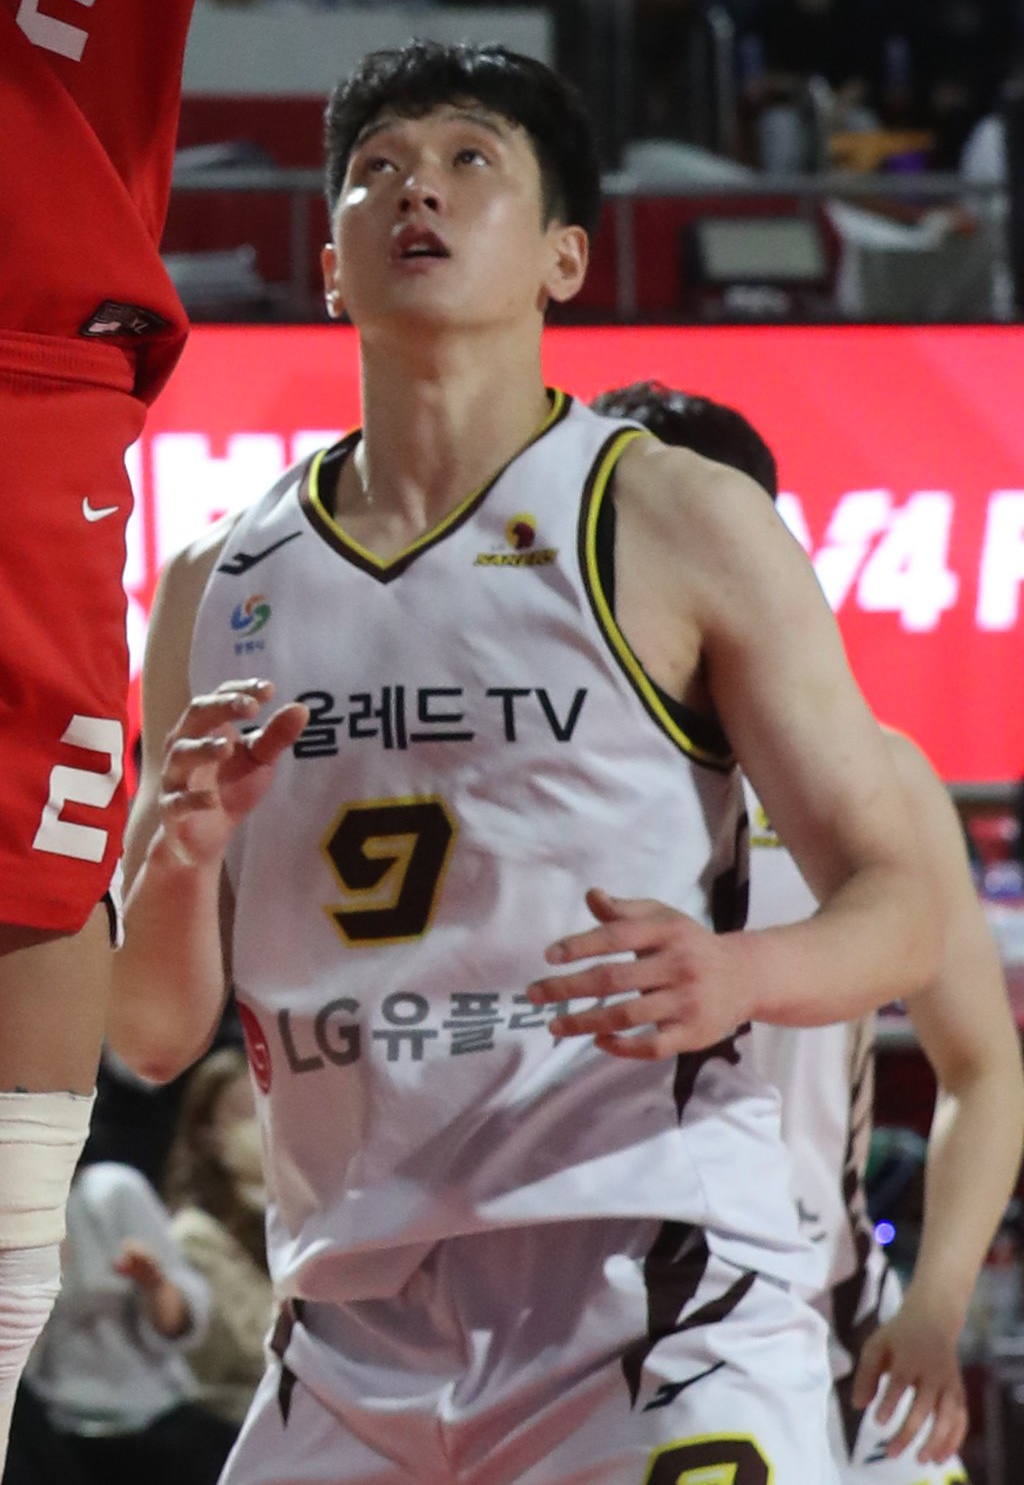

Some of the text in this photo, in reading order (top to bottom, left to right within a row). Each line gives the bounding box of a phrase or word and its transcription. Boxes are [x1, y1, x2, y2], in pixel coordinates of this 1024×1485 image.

[32, 714, 123, 863] 2
[292, 685, 588, 760] 올레드 TV
[323, 792, 458, 950] 9
